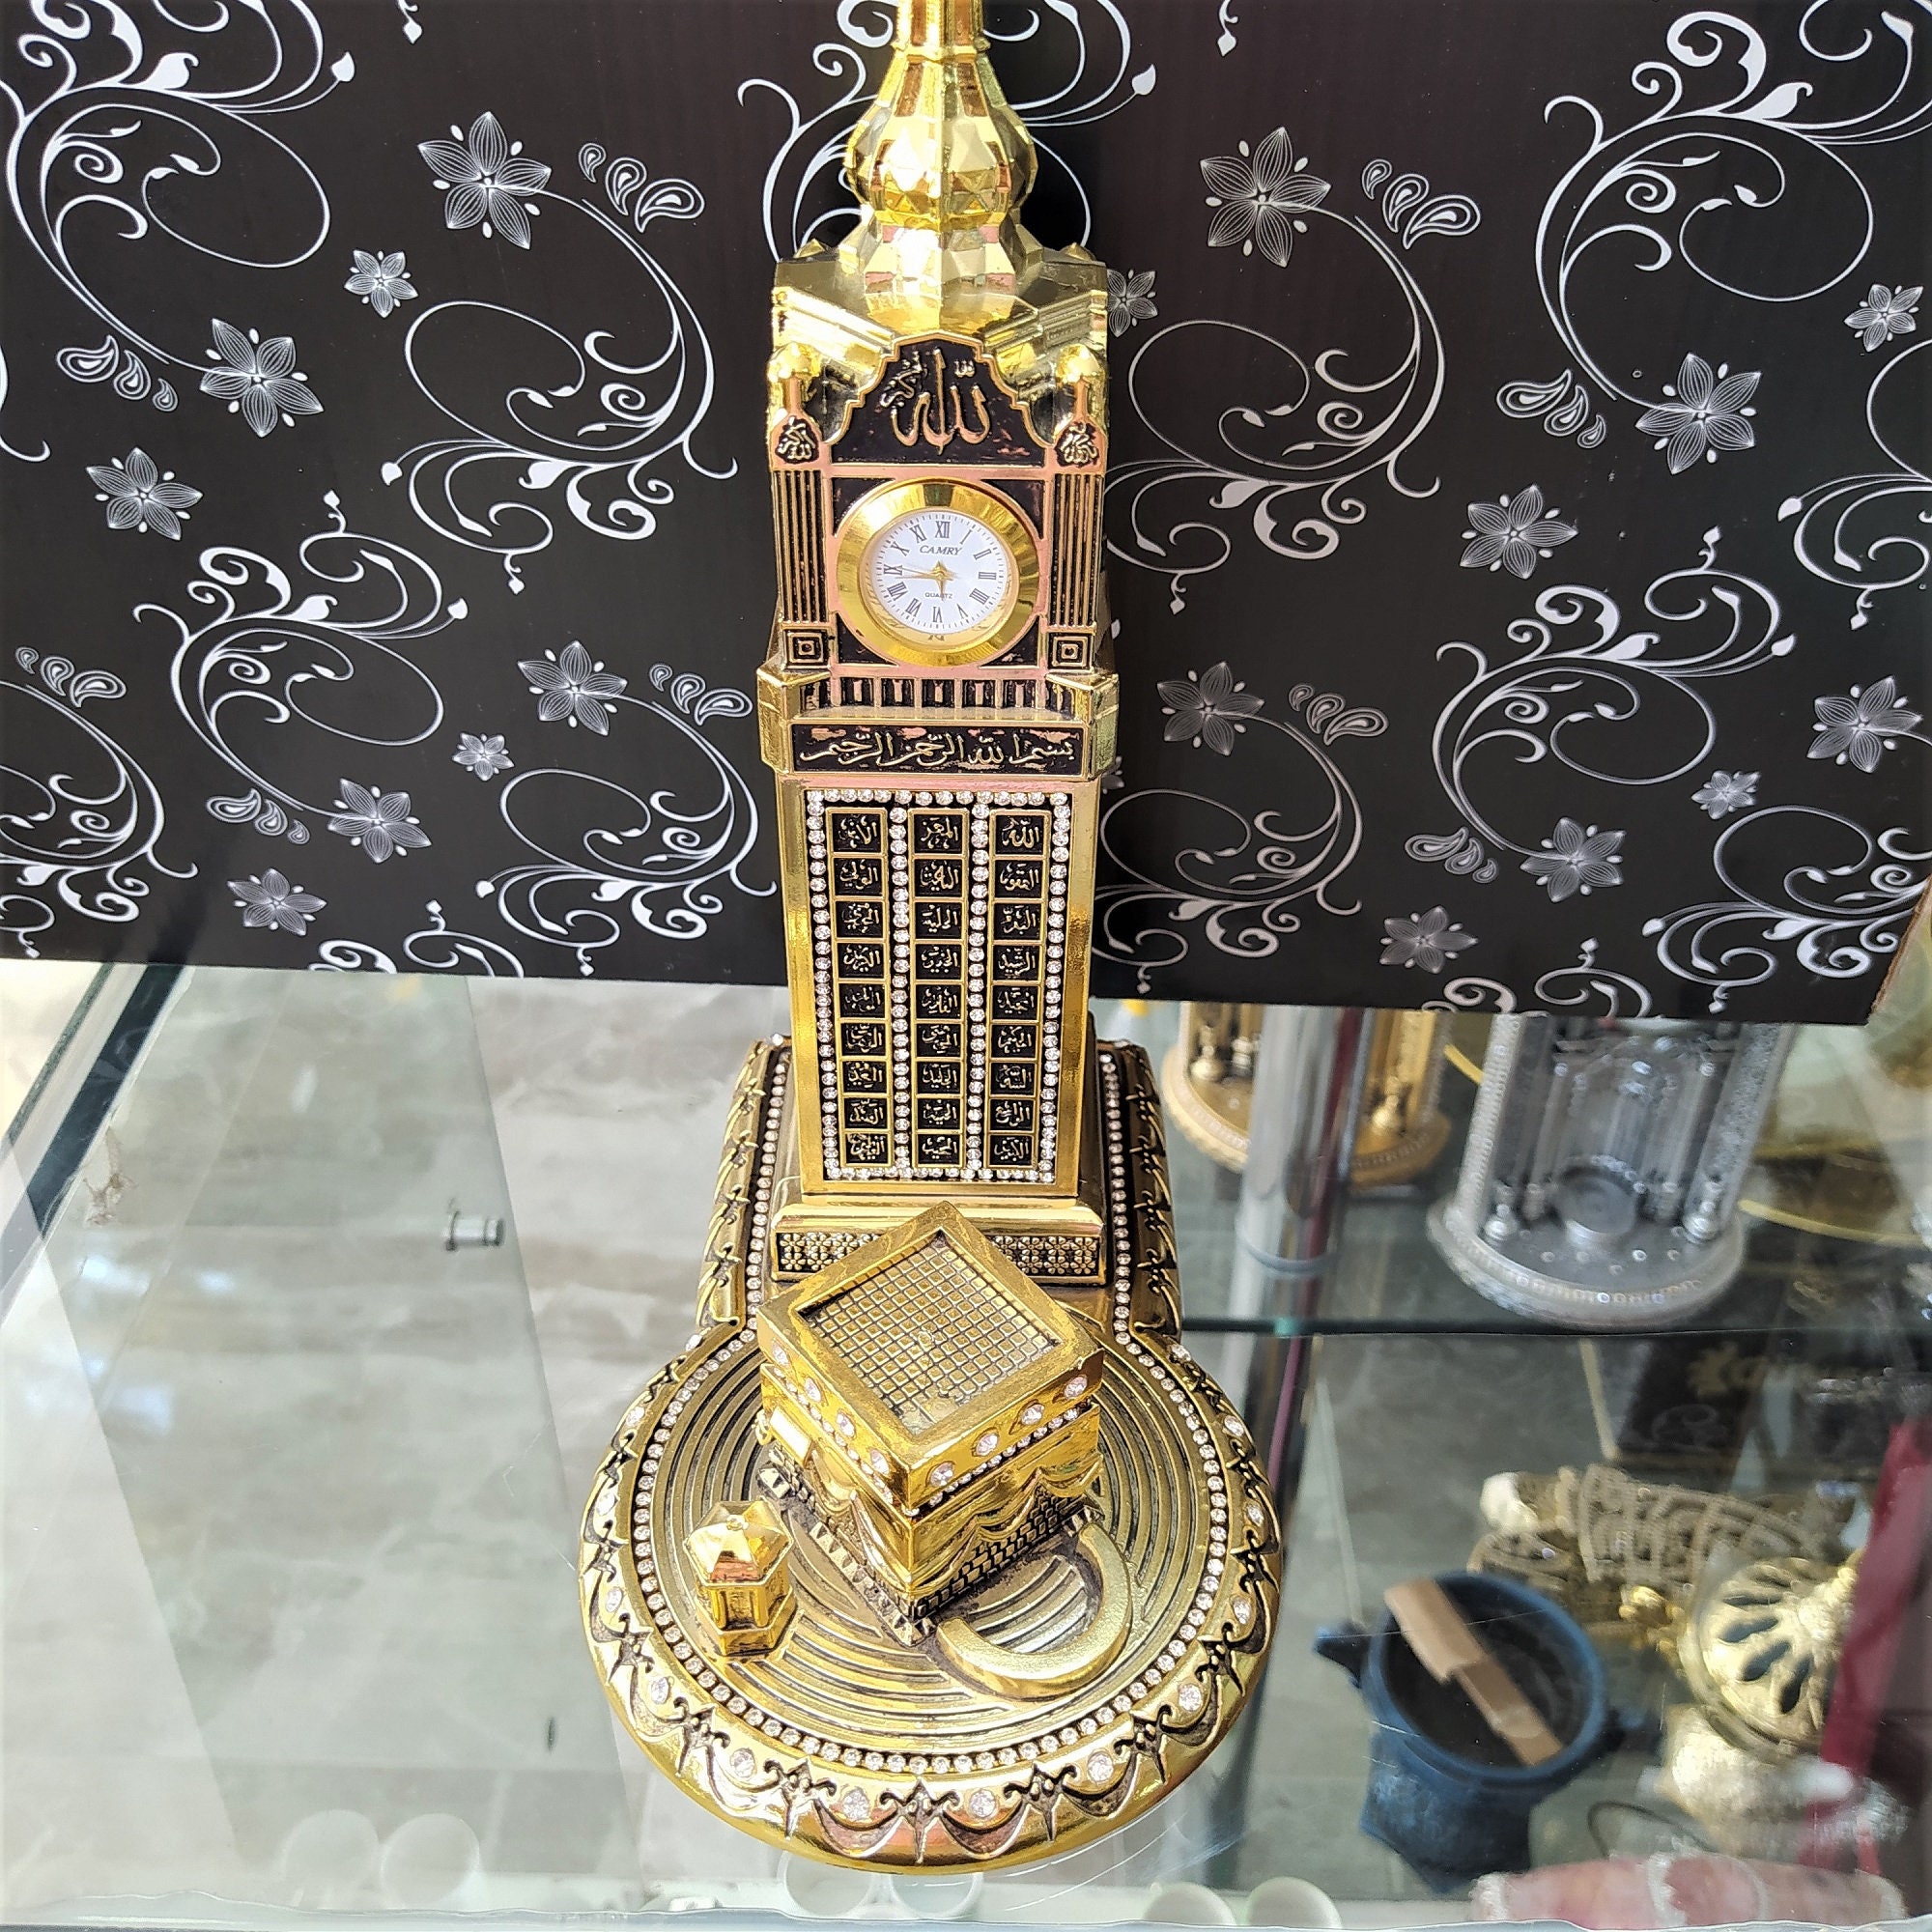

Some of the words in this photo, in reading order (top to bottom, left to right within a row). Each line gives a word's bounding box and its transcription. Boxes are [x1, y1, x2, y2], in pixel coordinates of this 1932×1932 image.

[934, 520, 952, 539] XII
[919, 544, 963, 556] CAMRY
[978, 571, 997, 581] III
[924, 591, 953, 600] QUATZ
